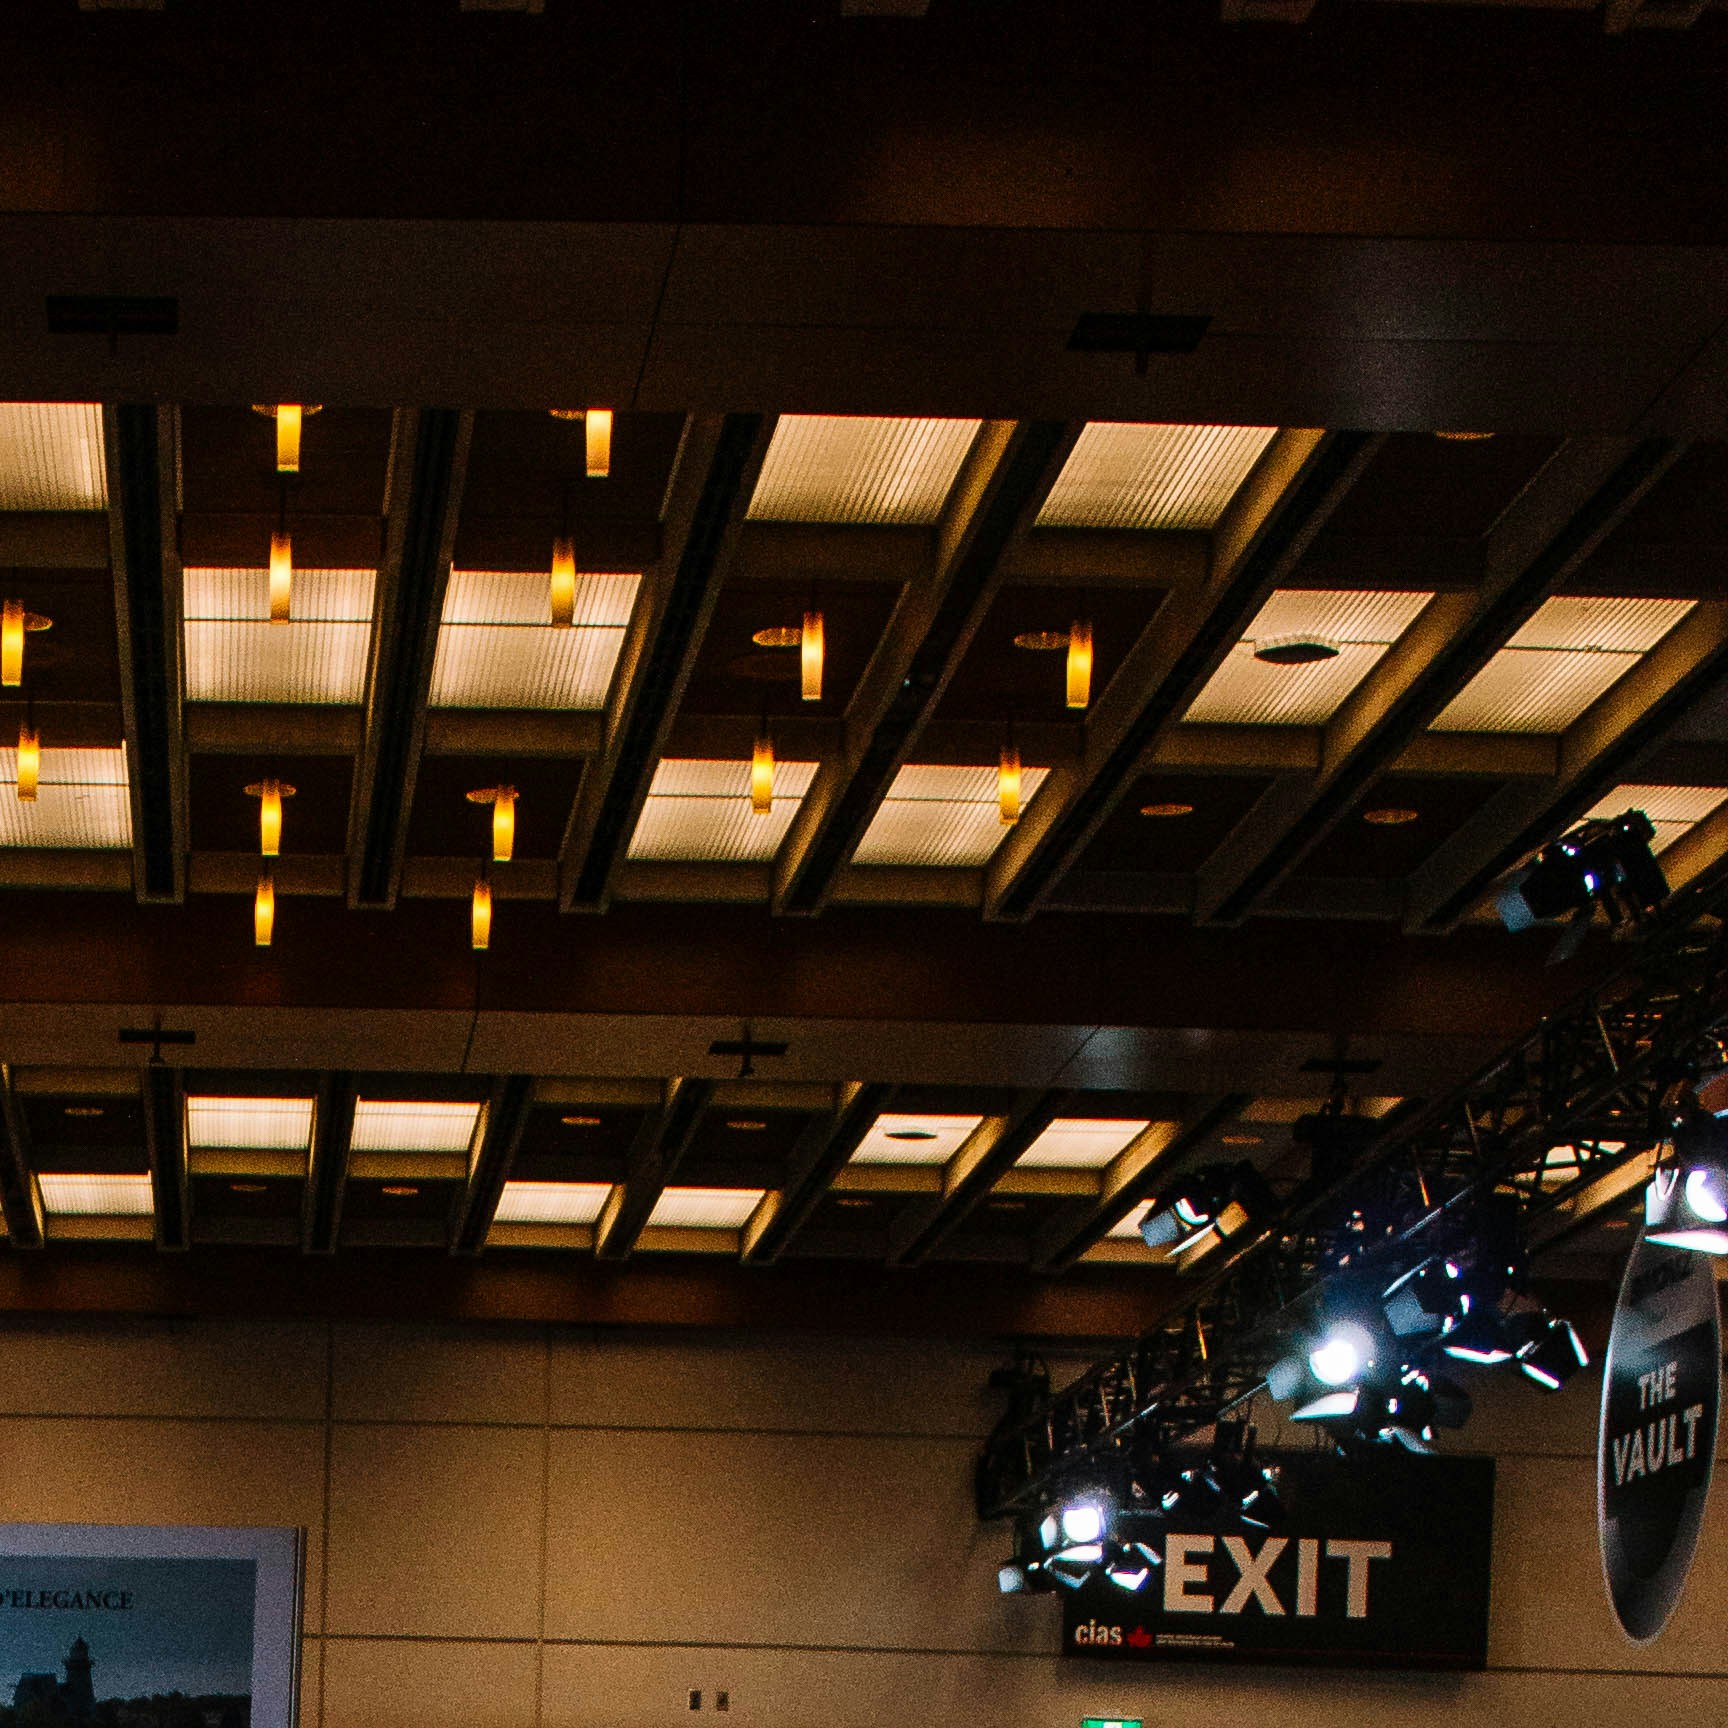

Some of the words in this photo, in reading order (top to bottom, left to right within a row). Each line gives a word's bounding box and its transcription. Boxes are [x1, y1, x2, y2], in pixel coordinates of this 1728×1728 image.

[1636, 1361, 1678, 1410] THE
[1612, 1404, 1703, 1487] VAULT
[1163, 1533, 1393, 1619] EXIT
